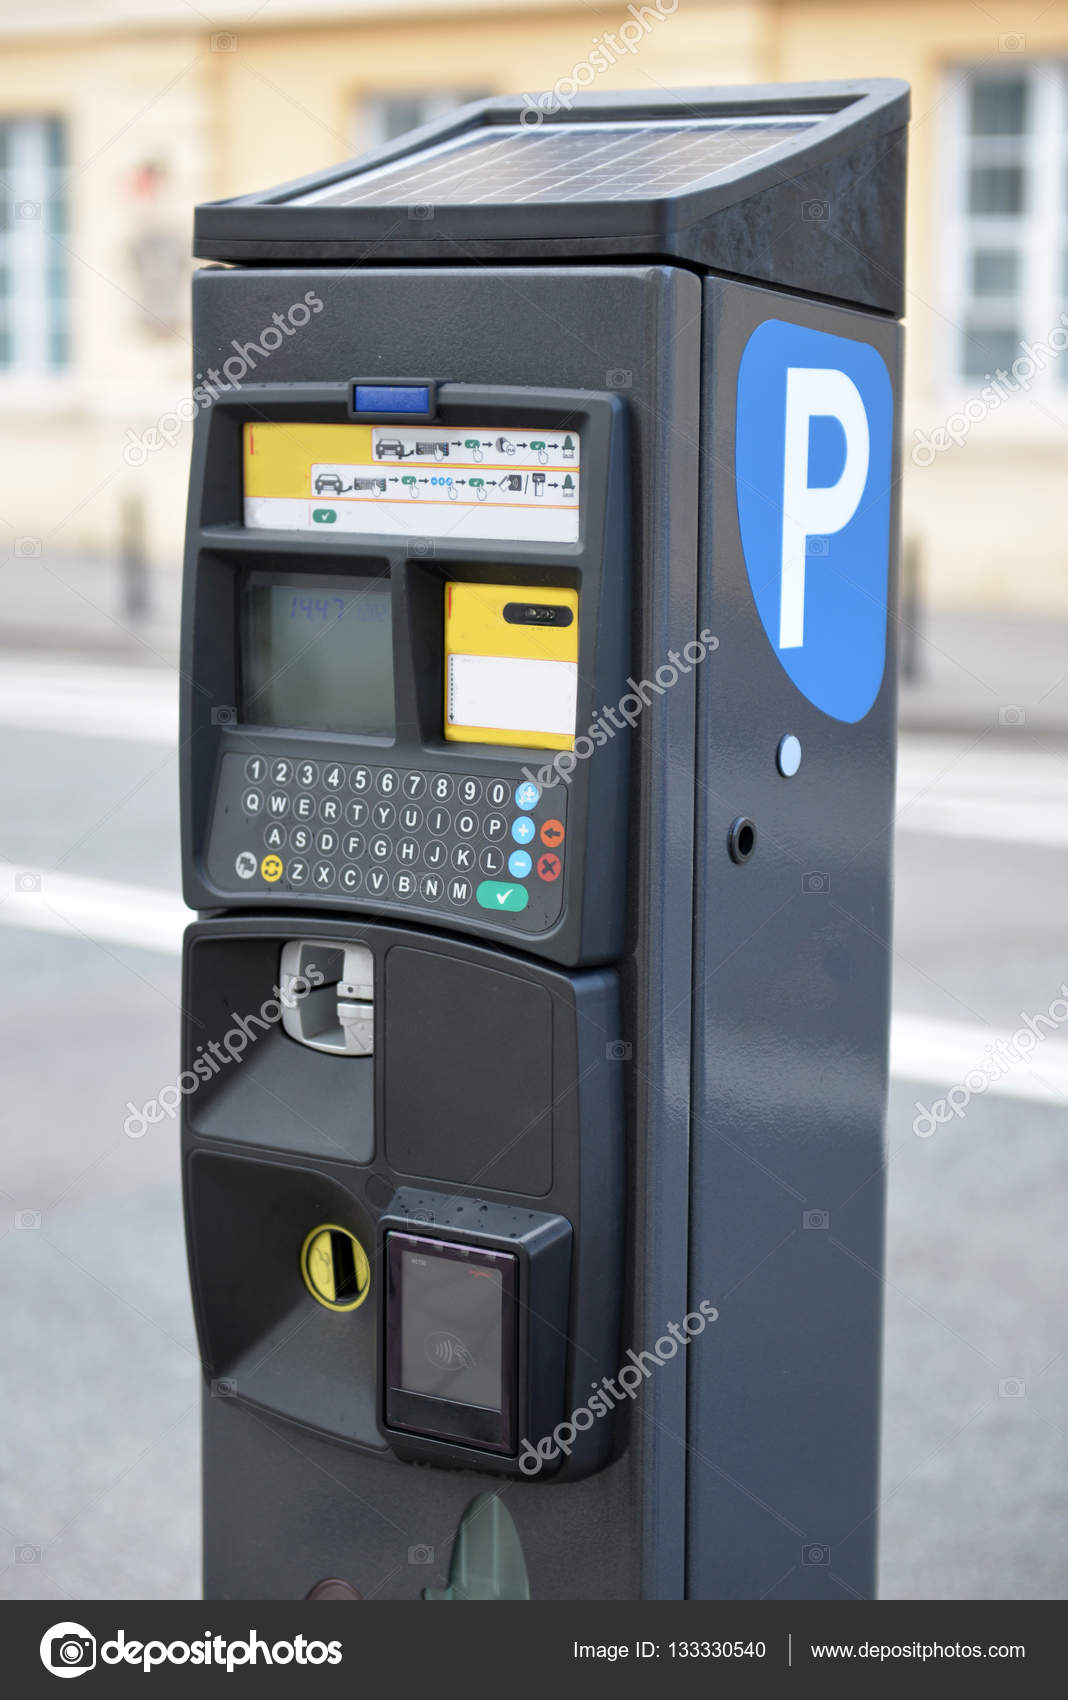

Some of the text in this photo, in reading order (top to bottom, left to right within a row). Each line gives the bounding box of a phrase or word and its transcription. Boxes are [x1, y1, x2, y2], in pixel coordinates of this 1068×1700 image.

[779, 367, 870, 649] P
[252, 760, 504, 803] 1 2 3 4 5 6 7 8 9 0
[246, 793, 501, 835] Q W E R T Y U I O P
[269, 828, 497, 869] A S D F G H J K L
[292, 863, 467, 899] Z X C V B N M
